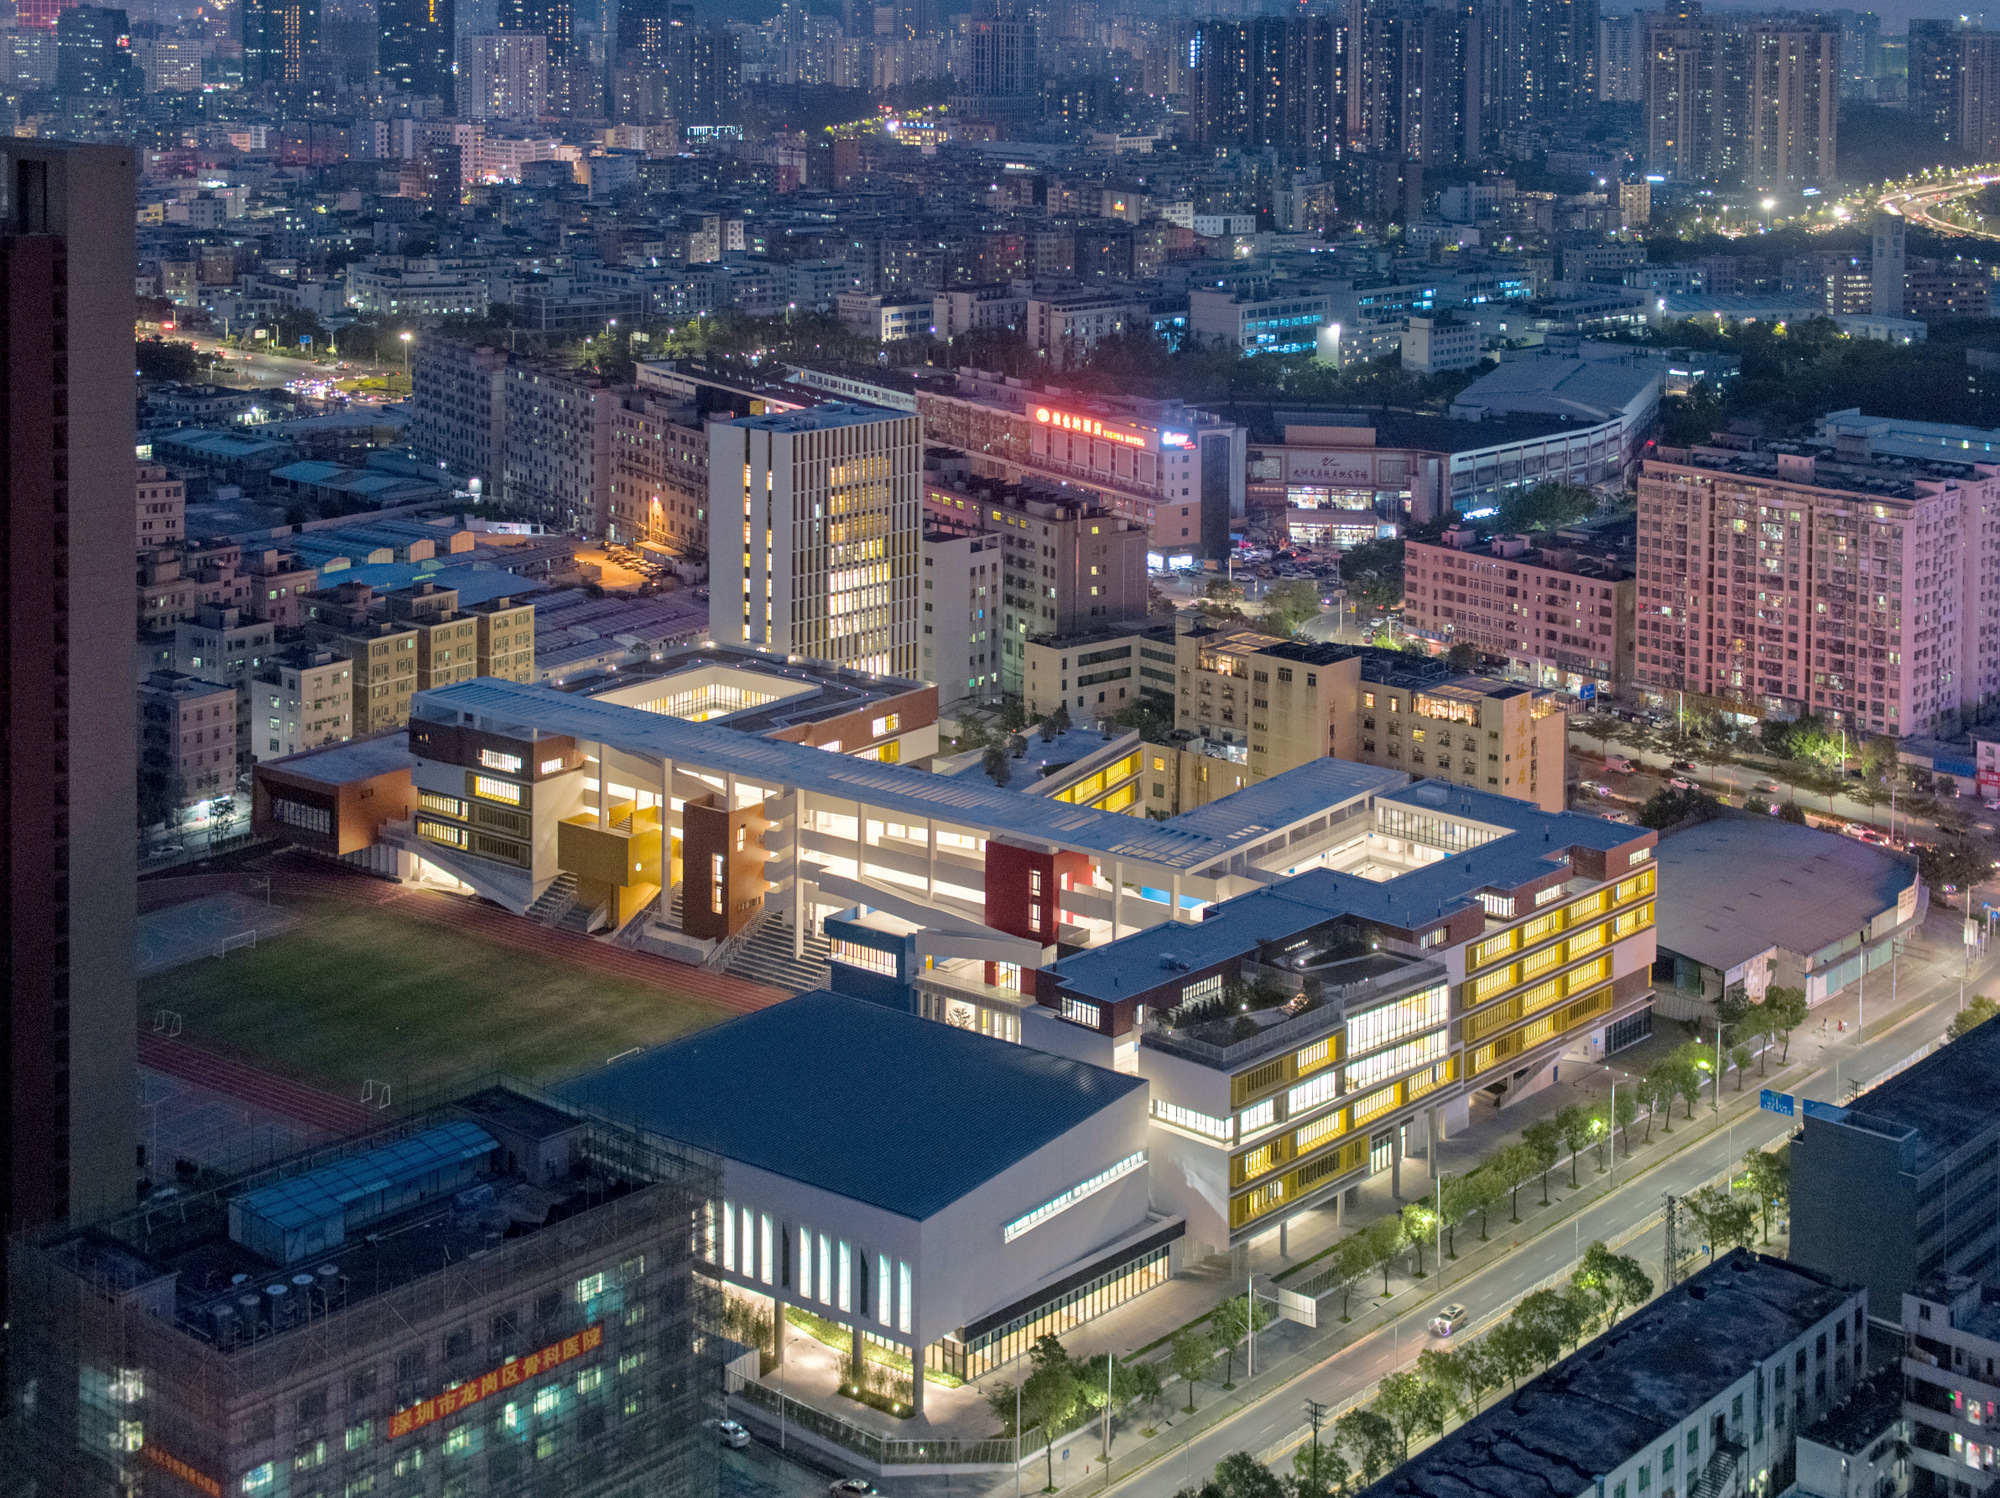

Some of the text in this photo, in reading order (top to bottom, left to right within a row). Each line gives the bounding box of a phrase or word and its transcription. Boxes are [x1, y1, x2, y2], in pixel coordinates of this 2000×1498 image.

[1125, 434, 1145, 447] HOTEL
[392, 1326, 601, 1436] 深圳市龙岗区骨科医院
